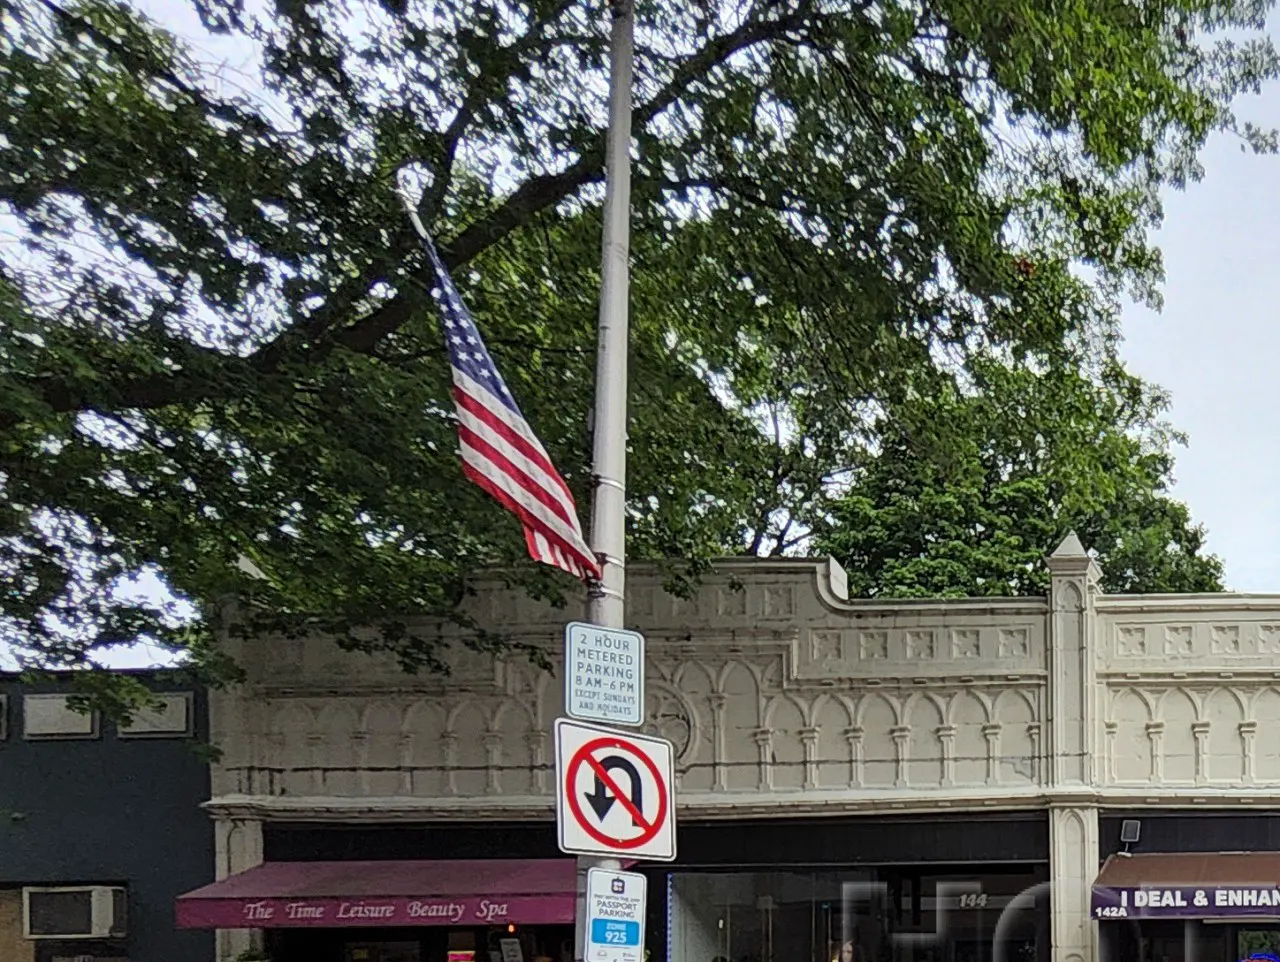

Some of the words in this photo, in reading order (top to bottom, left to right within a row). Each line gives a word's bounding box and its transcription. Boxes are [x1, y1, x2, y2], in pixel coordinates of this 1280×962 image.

[579, 634, 587, 645] 2
[595, 635, 629, 651] HOUR
[577, 647, 633, 665] METERED
[577, 661, 633, 679] PARKING
[576, 675, 582, 685] 8
[620, 681, 634, 693] PM
[575, 689, 601, 700] EXCEPT
[603, 693, 635, 705] SUNDAYS
[579, 701, 594, 710] AND
[597, 703, 631, 715] HOLIDAYS
[597, 900, 637, 911] PASSPORT
[959, 893, 988, 908] 144
[1121, 890, 1128, 907] I
[1134, 890, 1188, 907] DEAL
[1193, 890, 1208, 907] &
[243, 901, 274, 919] The
[286, 902, 325, 919] Time
[336, 901, 395, 919] Leisure
[407, 901, 465, 921] Beauty
[475, 900, 508, 921] Spa
[599, 908, 635, 918] PARKING
[1095, 906, 1128, 917] 142A
[605, 931, 627, 944] 925
